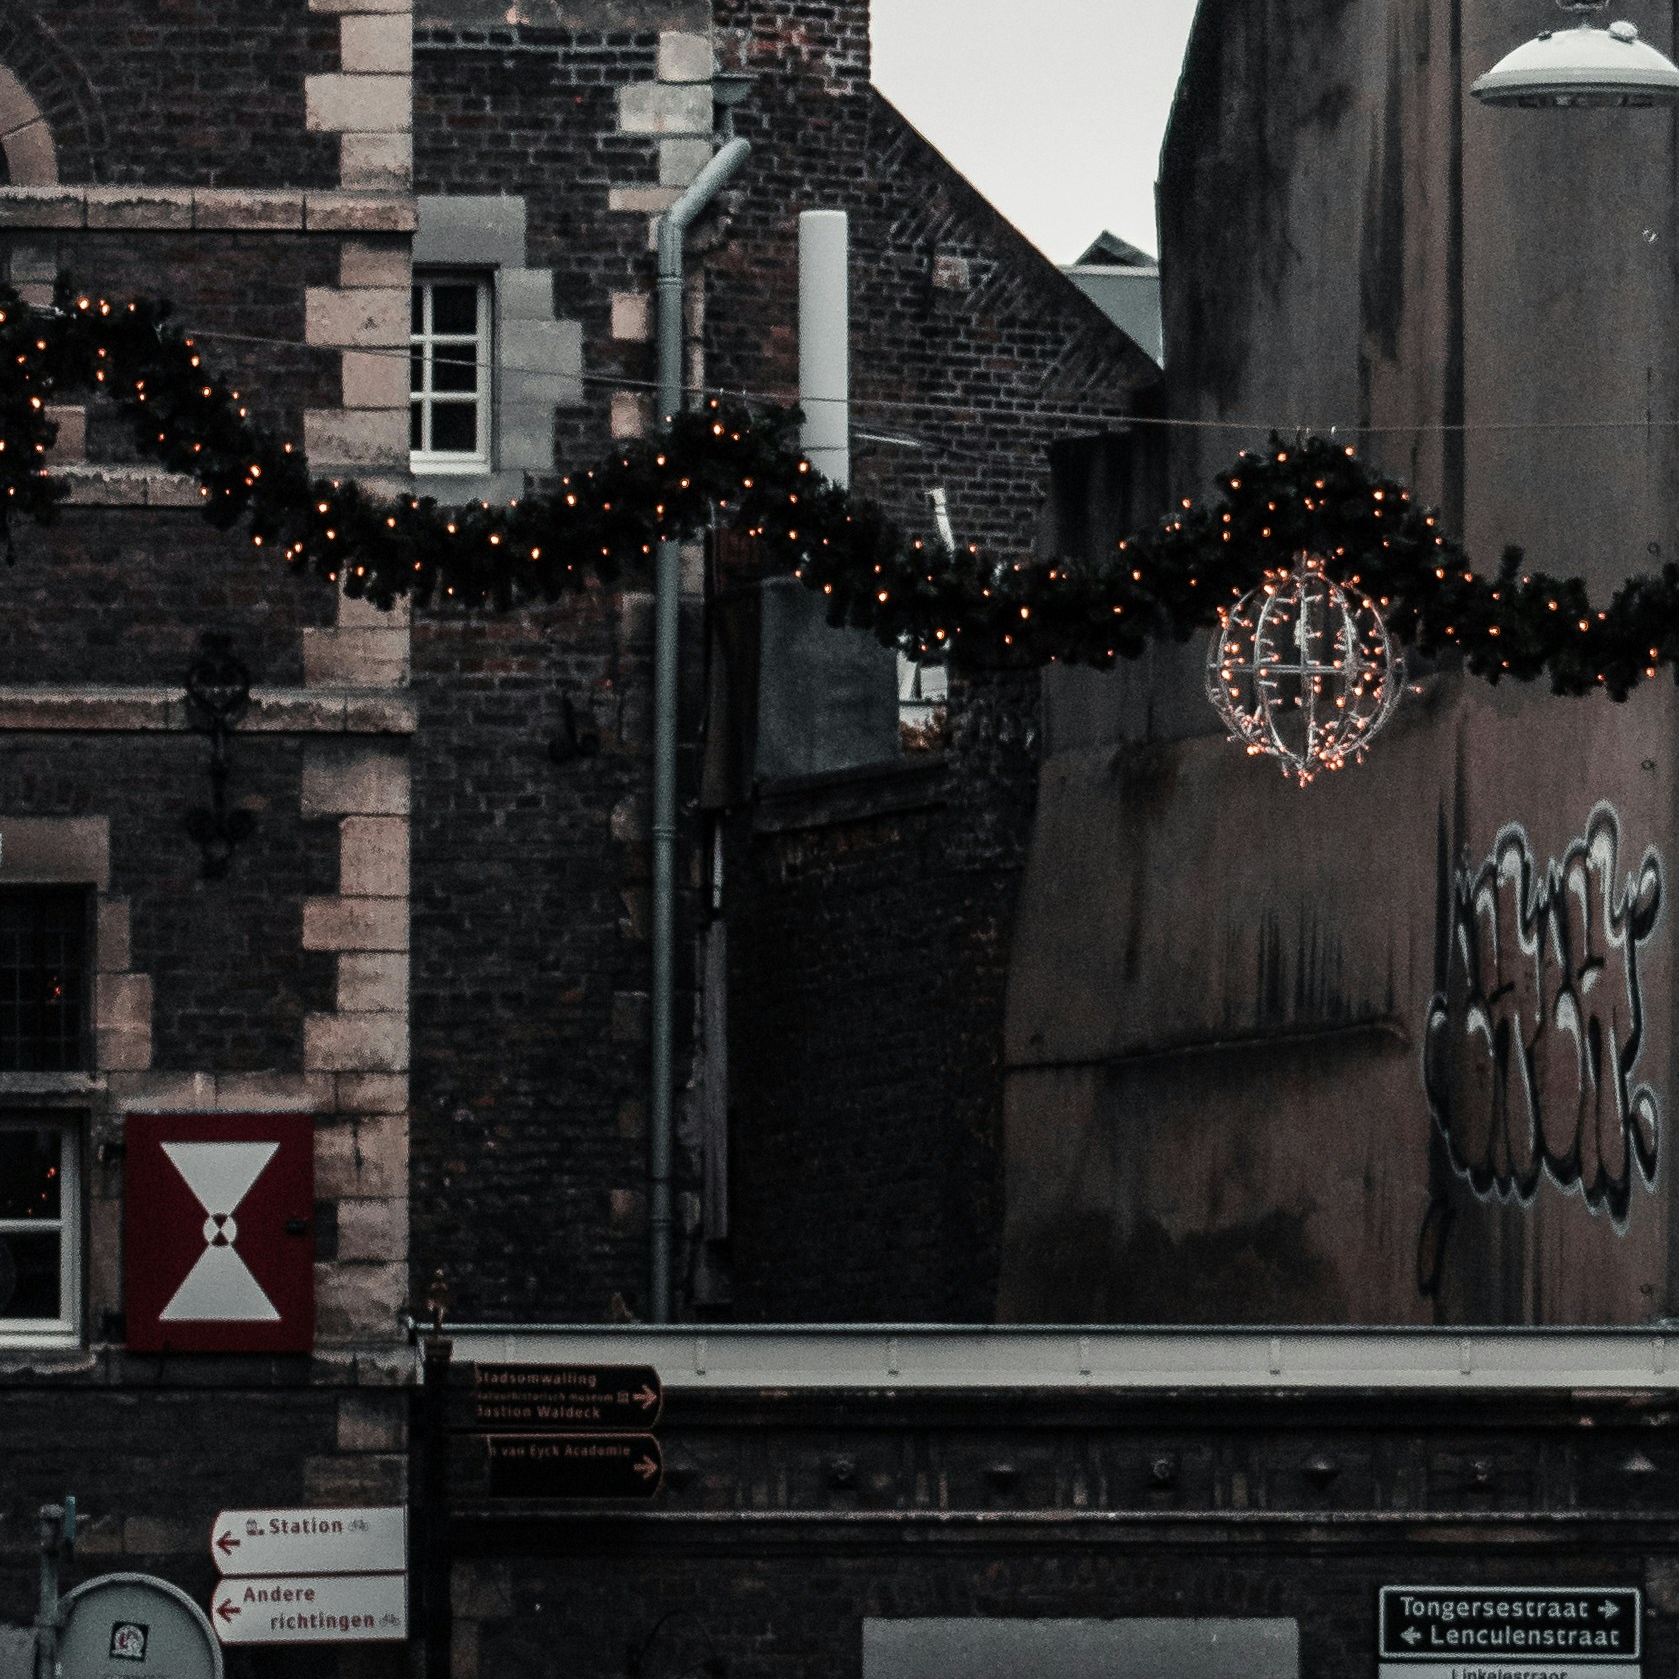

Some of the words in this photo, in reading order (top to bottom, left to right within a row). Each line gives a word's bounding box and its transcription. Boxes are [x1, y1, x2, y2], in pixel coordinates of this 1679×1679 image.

[537, 1405, 600, 1418] Waldeck
[501, 1446, 525, 1457] van
[530, 1444, 560, 1459] Eyck
[564, 1445, 631, 1457] Academie
[269, 1517, 343, 1534] Station
[243, 1586, 316, 1603] Andere
[1400, 1596, 1589, 1621] Tongersestraat
[270, 1612, 375, 1632] richtingen
[1430, 1624, 1620, 1646] Lenculenstraat
